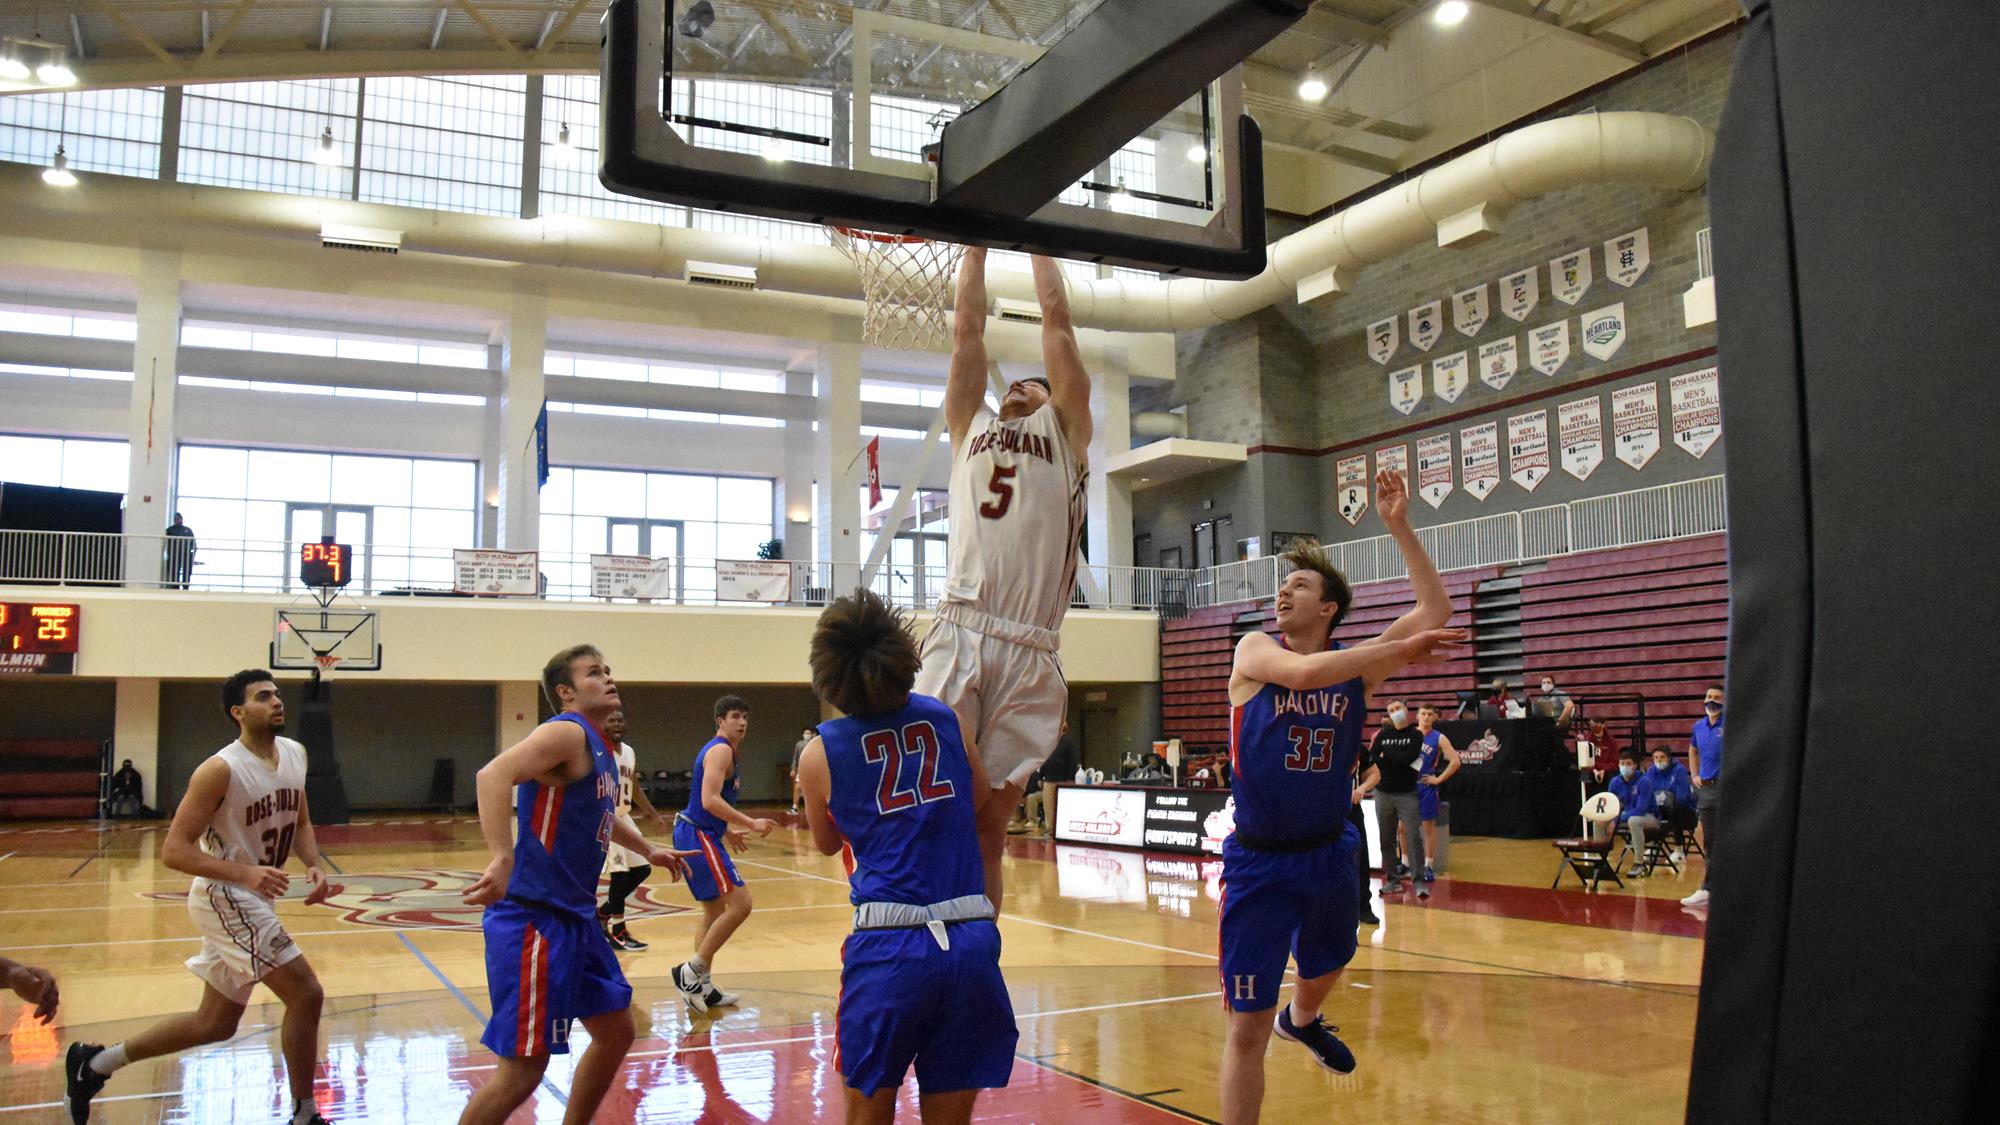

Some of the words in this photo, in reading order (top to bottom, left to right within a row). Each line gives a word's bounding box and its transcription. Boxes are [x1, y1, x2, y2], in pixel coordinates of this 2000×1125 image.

[1585, 320, 1623, 340] HEARTLAND
[1671, 371, 1717, 387] ROSE-HULMAN
[1613, 385, 1655, 399] ROSE-HULMAN
[1684, 387, 1706, 399] MEN'S
[1624, 400, 1645, 410] MEN'S
[1673, 395, 1720, 412] BASKETBALL
[1570, 413, 1589, 423] MEN'S
[1615, 405, 1657, 420] BASKETBALL
[1519, 426, 1536, 435] MEN'S
[1561, 418, 1599, 433] BASKETBALL
[1616, 421, 1657, 436] CHAMPIONS
[1675, 414, 1719, 432] CHAMPIONS
[1471, 438, 1487, 447] MEN'S
[1510, 432, 1546, 445] BASKETBALL
[1562, 431, 1600, 447] CHAMPIONS
[1463, 443, 1496, 456] BASKETBALL
[1512, 453, 1547, 471] CHAMPIONS
[1527, 469, 1534, 480] R
[980, 464, 1016, 519] 5
[1434, 488, 1439, 497] R
[1478, 480, 1485, 490] R
[1349, 489, 1357, 504] R
[303, 545, 339, 561] 37.3
[327, 561, 340, 582] 7
[32, 606, 73, 617] PANTHERS
[38, 618, 68, 640] 25
[13, 634, 20, 650] 1
[1285, 725, 1334, 772] 33
[862, 720, 956, 816] 22
[1597, 797, 1607, 813] R
[258, 822, 296, 869] 30
[1233, 974, 1257, 1000] H
[551, 1018, 569, 1044] H
